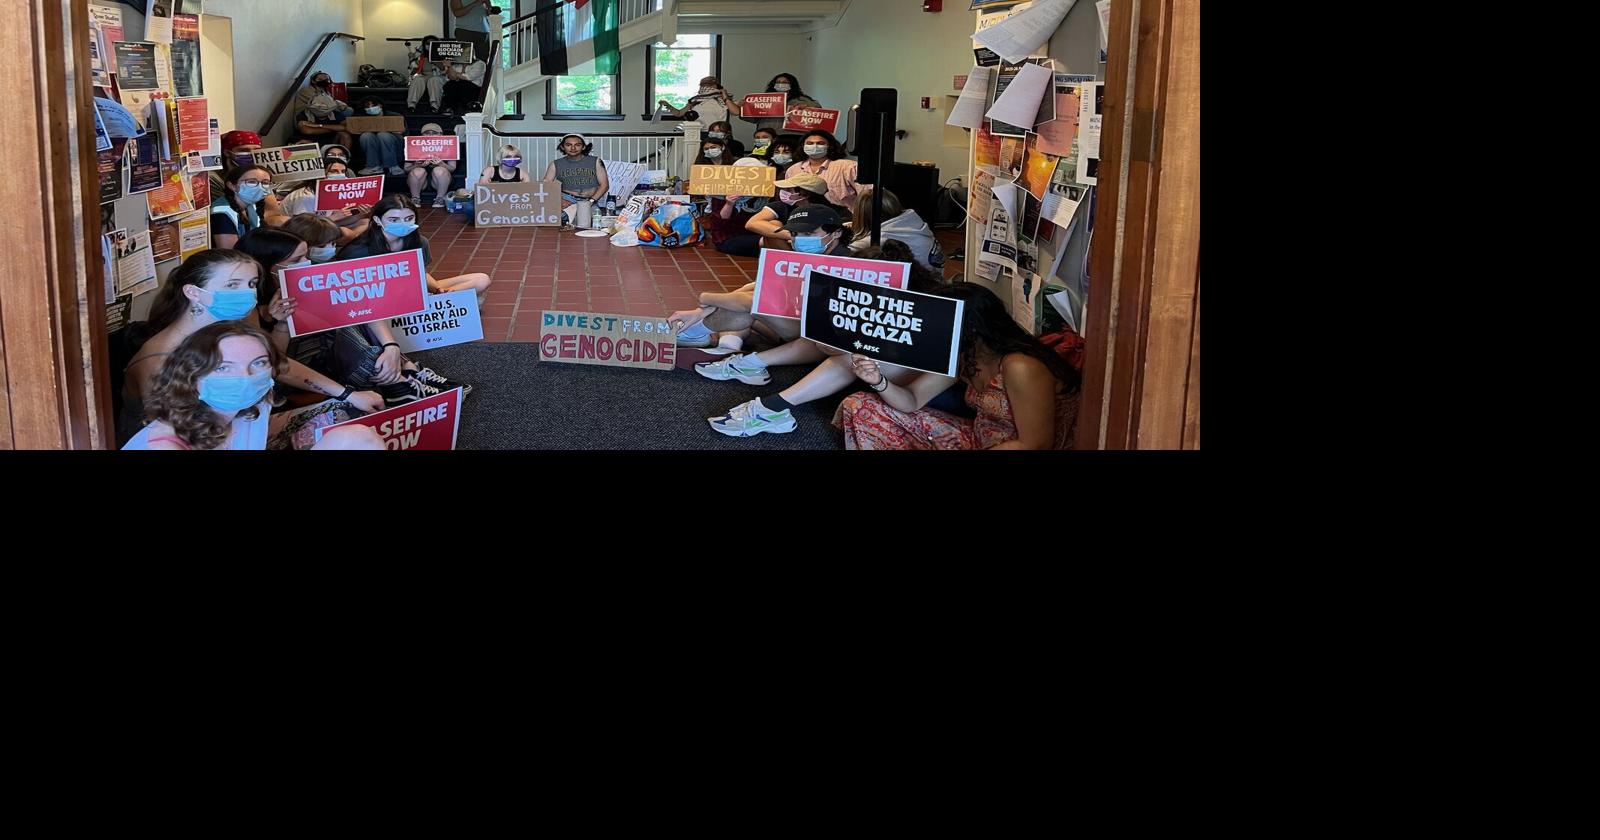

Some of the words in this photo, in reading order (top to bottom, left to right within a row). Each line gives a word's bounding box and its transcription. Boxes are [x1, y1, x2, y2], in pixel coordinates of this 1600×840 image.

[792, 110, 835, 120] CEASEFIRE
[801, 116, 823, 124] NOW
[254, 151, 282, 165] FREE
[266, 157, 325, 176] ALESTINE
[325, 180, 378, 192] CEASEFIRE
[339, 190, 365, 200] NOW
[477, 184, 548, 204] Divest
[477, 207, 559, 225] Genocide
[298, 261, 411, 292] CEASEFIRE
[330, 282, 385, 305] NOW
[838, 287, 873, 306] END
[877, 296, 915, 315] THE
[434, 300, 455, 310] U.S.
[391, 311, 445, 328] MILITARY
[449, 308, 467, 318] AID
[544, 313, 617, 331] DIVEST
[622, 320, 670, 334] FROM
[829, 299, 923, 332] BLOCKADE
[402, 326, 419, 336] TO
[422, 319, 460, 333] ISRAEL
[832, 315, 857, 332] ON
[861, 323, 913, 345] GAZA
[541, 333, 675, 364] GENOCIDE
[863, 344, 880, 353] AFSC
[372, 402, 448, 438] SEFIRE
[386, 429, 421, 449] OW
